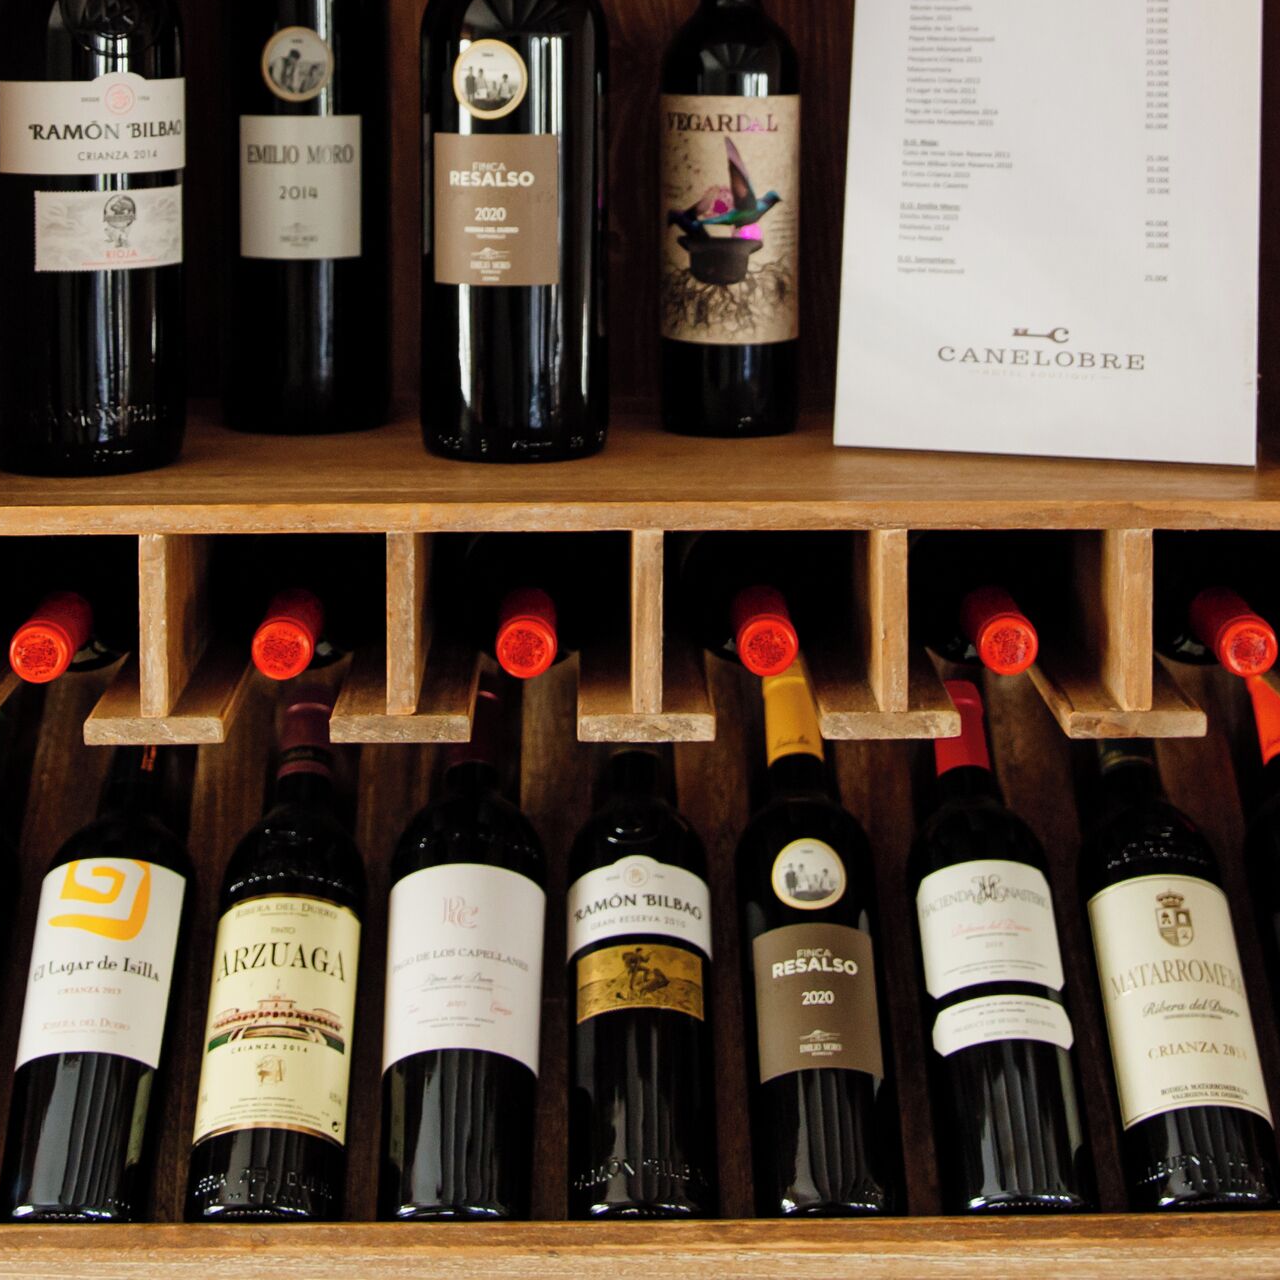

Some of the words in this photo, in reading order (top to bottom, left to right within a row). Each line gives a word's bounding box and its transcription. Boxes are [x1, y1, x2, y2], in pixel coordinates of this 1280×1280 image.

[28, 120, 120, 141] RAMÓN
[77, 151, 130, 162] CRIANZA
[134, 149, 158, 160] 2014
[247, 144, 300, 164] EMILIO
[306, 143, 356, 164] MORO
[472, 162, 508, 173] FINCA
[448, 170, 537, 188] RESALSO
[279, 185, 319, 200] 2014
[474, 206, 508, 222] 2020
[105, 248, 139, 260] RIOJA
[937, 345, 1146, 371] CANELOBRE
[275, 903, 297, 911] DEL
[574, 892, 637, 922] RAMÓN
[642, 893, 703, 920] BILBAO
[432, 948, 456, 960] LOS
[796, 947, 833, 958] FINCA
[97, 954, 118, 970] de
[216, 941, 347, 983] ARZUAGA
[772, 956, 859, 979] RESALSO
[801, 989, 836, 1006] 2020
[1142, 1000, 1186, 1018] Ribera
[1188, 997, 1208, 1011] del
[230, 1043, 277, 1055] CRIANZA
[1147, 1040, 1220, 1061] CRIANZA
